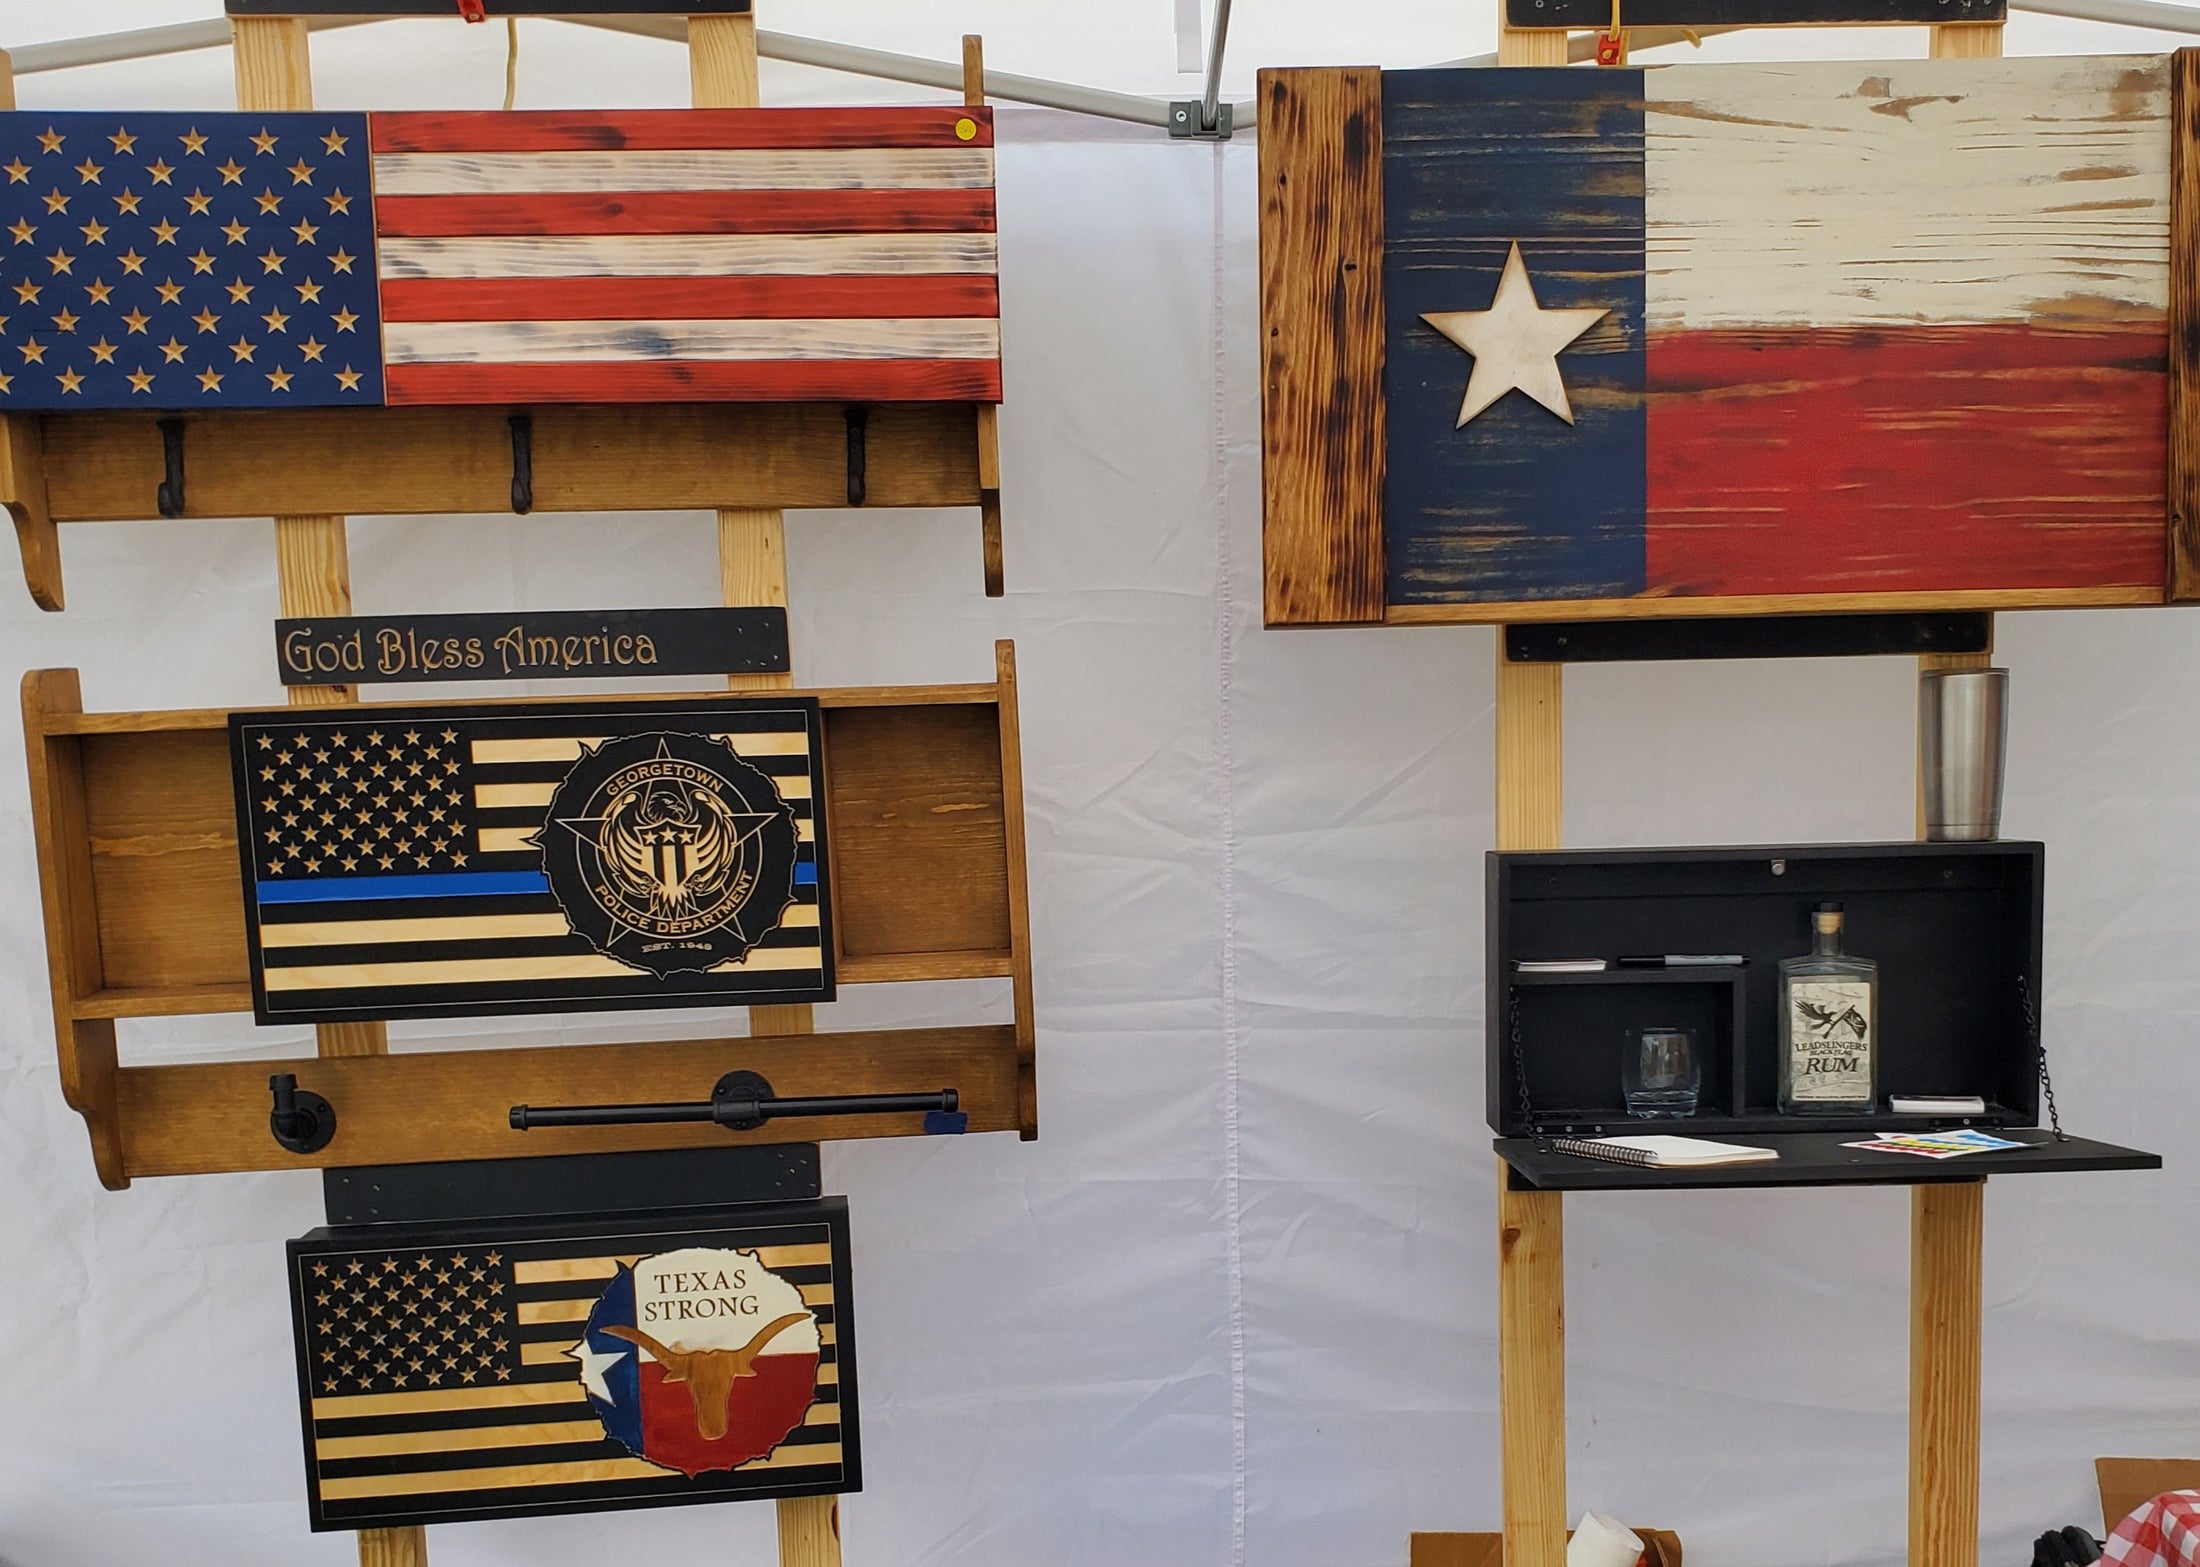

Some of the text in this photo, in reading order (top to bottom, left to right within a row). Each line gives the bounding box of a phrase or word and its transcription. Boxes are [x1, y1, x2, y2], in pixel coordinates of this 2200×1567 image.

[284, 624, 658, 675] God Bless America
[606, 763, 724, 797] GEORGETOWN
[594, 870, 753, 934] POLICE DEPARTMENT
[641, 942, 675, 953] EST.
[1795, 1041, 1868, 1052] LEADSLINGERS
[1802, 1057, 1860, 1075] RUM
[653, 1269, 747, 1295] TEXAS
[644, 1295, 760, 1322] STRONG
